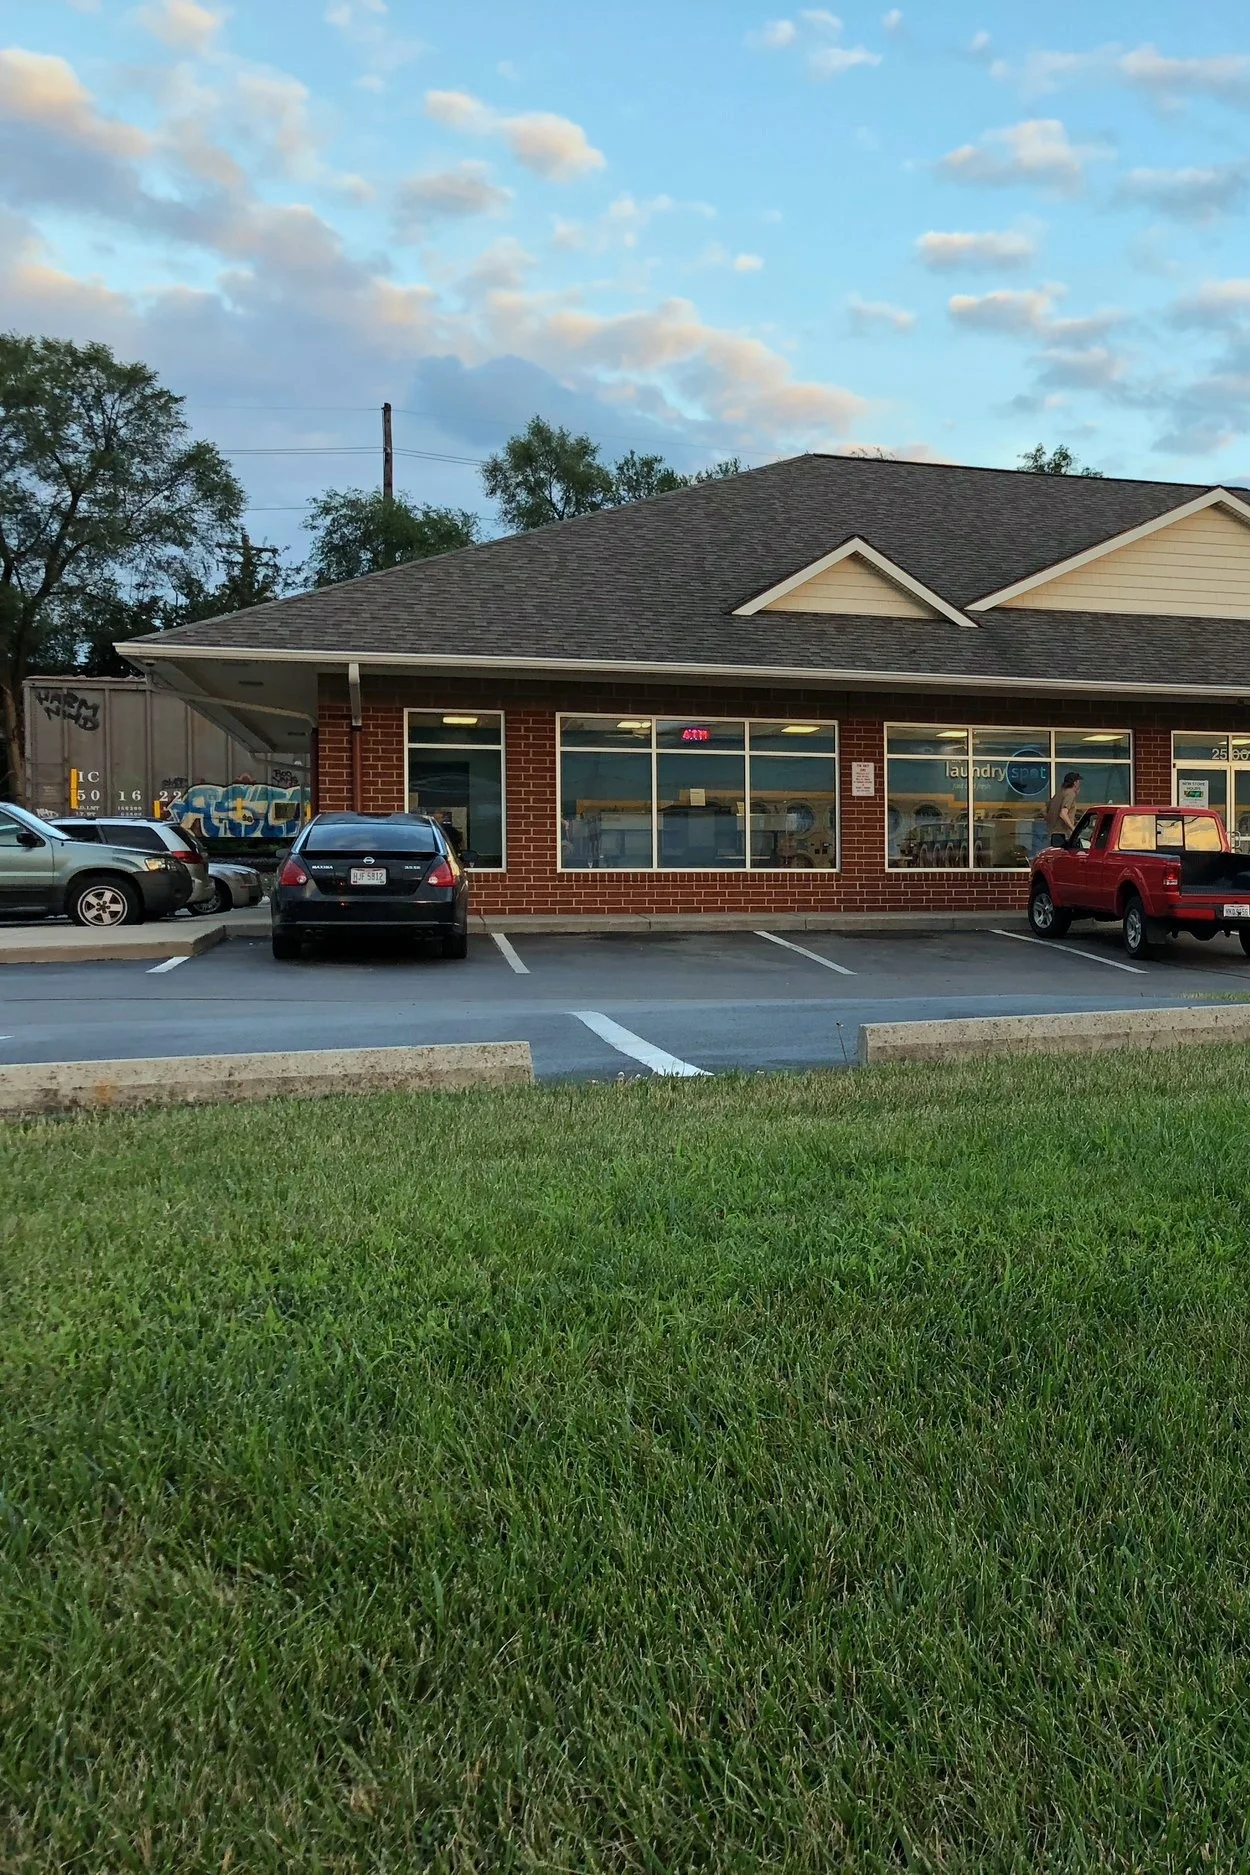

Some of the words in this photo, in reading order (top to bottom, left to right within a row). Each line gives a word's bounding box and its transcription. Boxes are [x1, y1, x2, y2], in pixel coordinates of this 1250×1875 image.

[1212, 748, 1249, 760] 2500
[78, 771, 100, 783] IC
[945, 761, 1006, 781] laundry
[1011, 766, 1047, 782] spot
